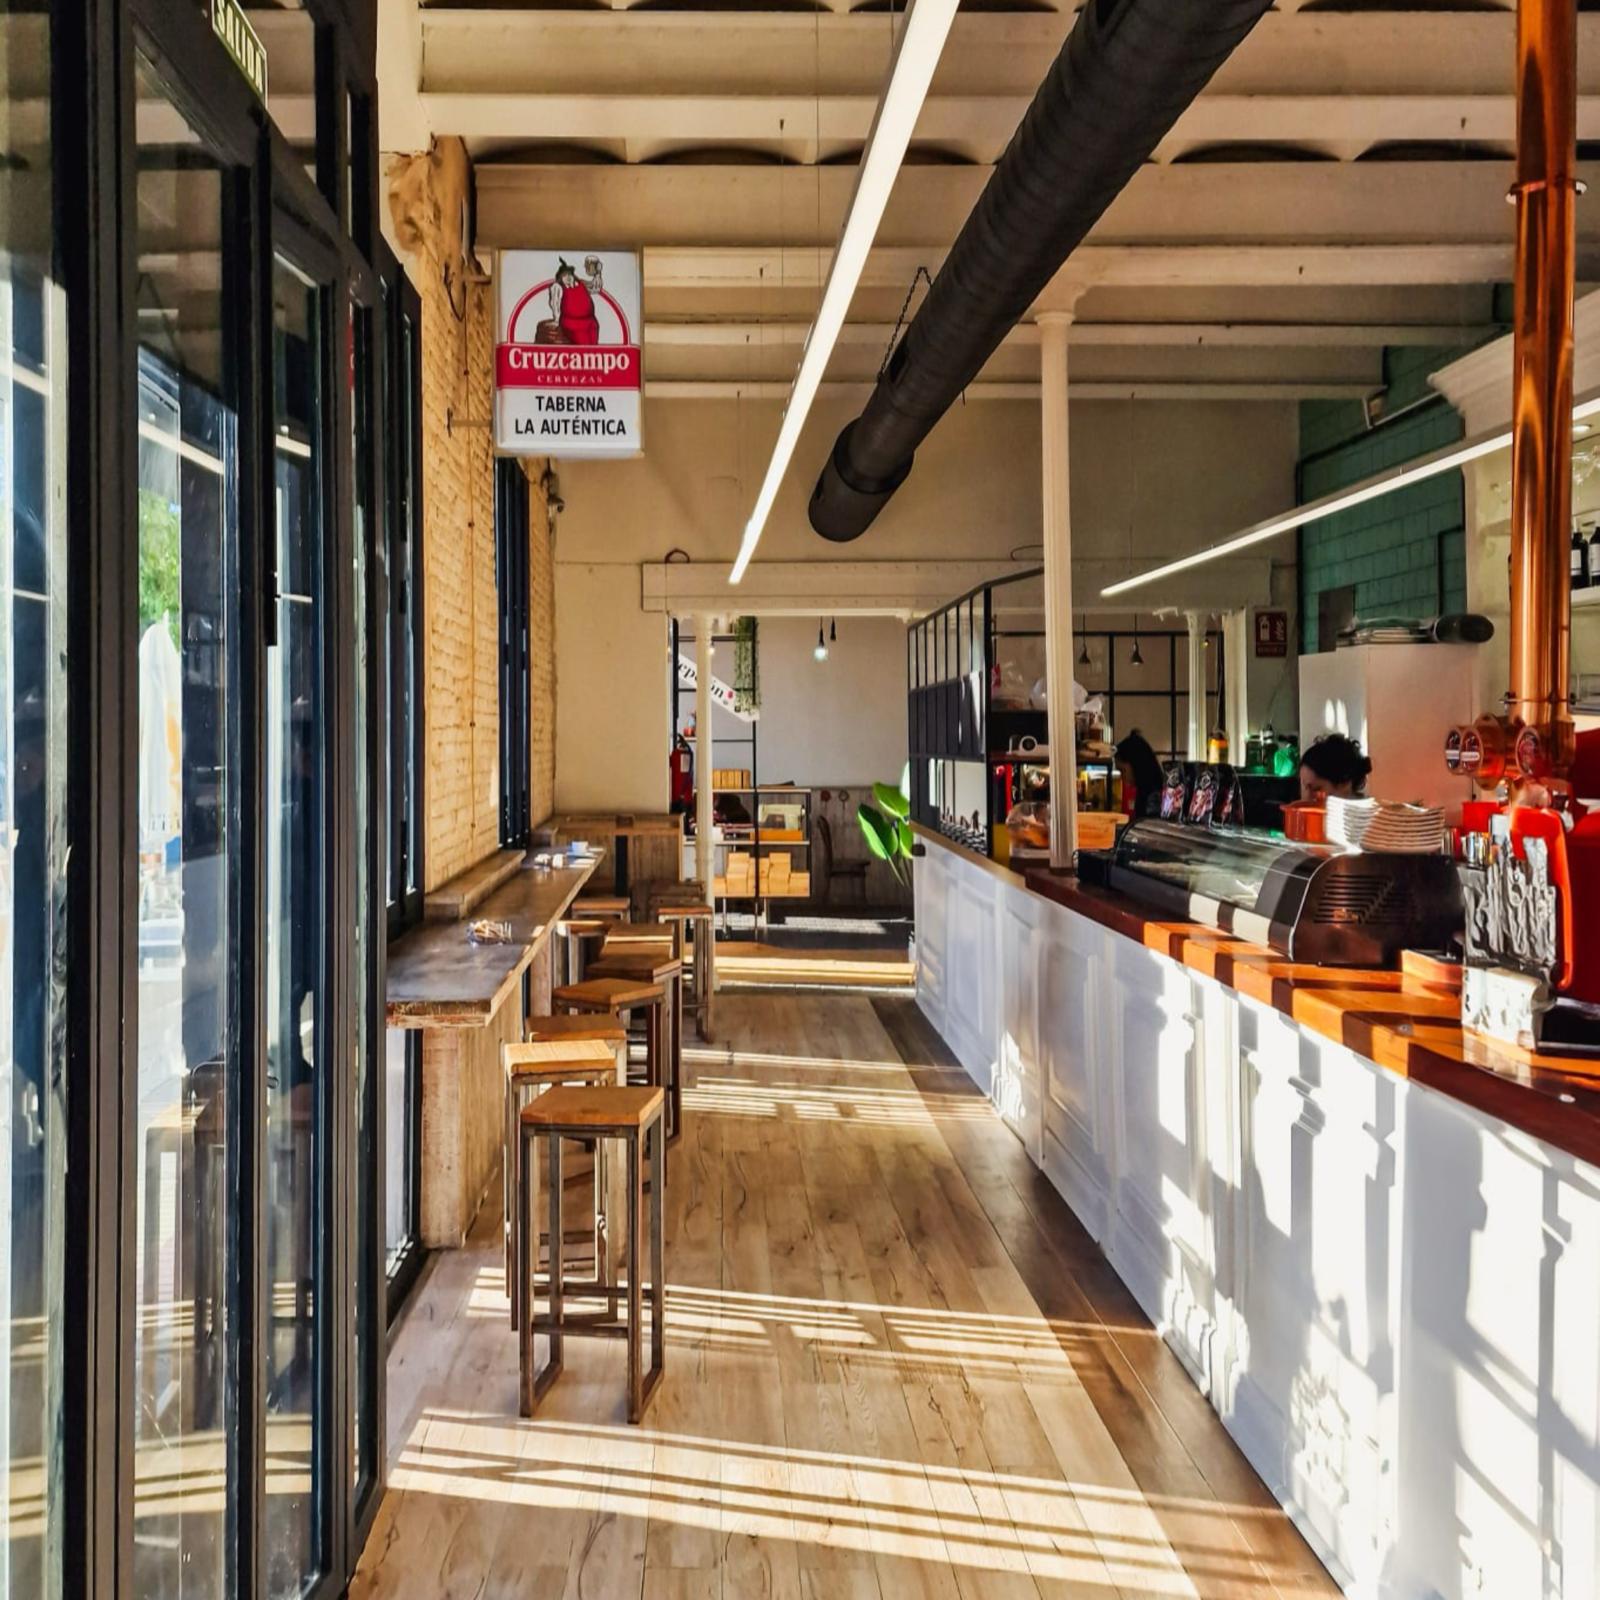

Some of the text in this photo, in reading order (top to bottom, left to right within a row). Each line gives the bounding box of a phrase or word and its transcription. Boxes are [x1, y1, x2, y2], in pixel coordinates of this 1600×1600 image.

[217, 0, 263, 93] SALIDA
[508, 347, 630, 374] Cruzcampo
[537, 375, 603, 384] CERVEZAS
[535, 395, 606, 412] TABERNA
[515, 415, 627, 436] LA AUTÉNTICA
